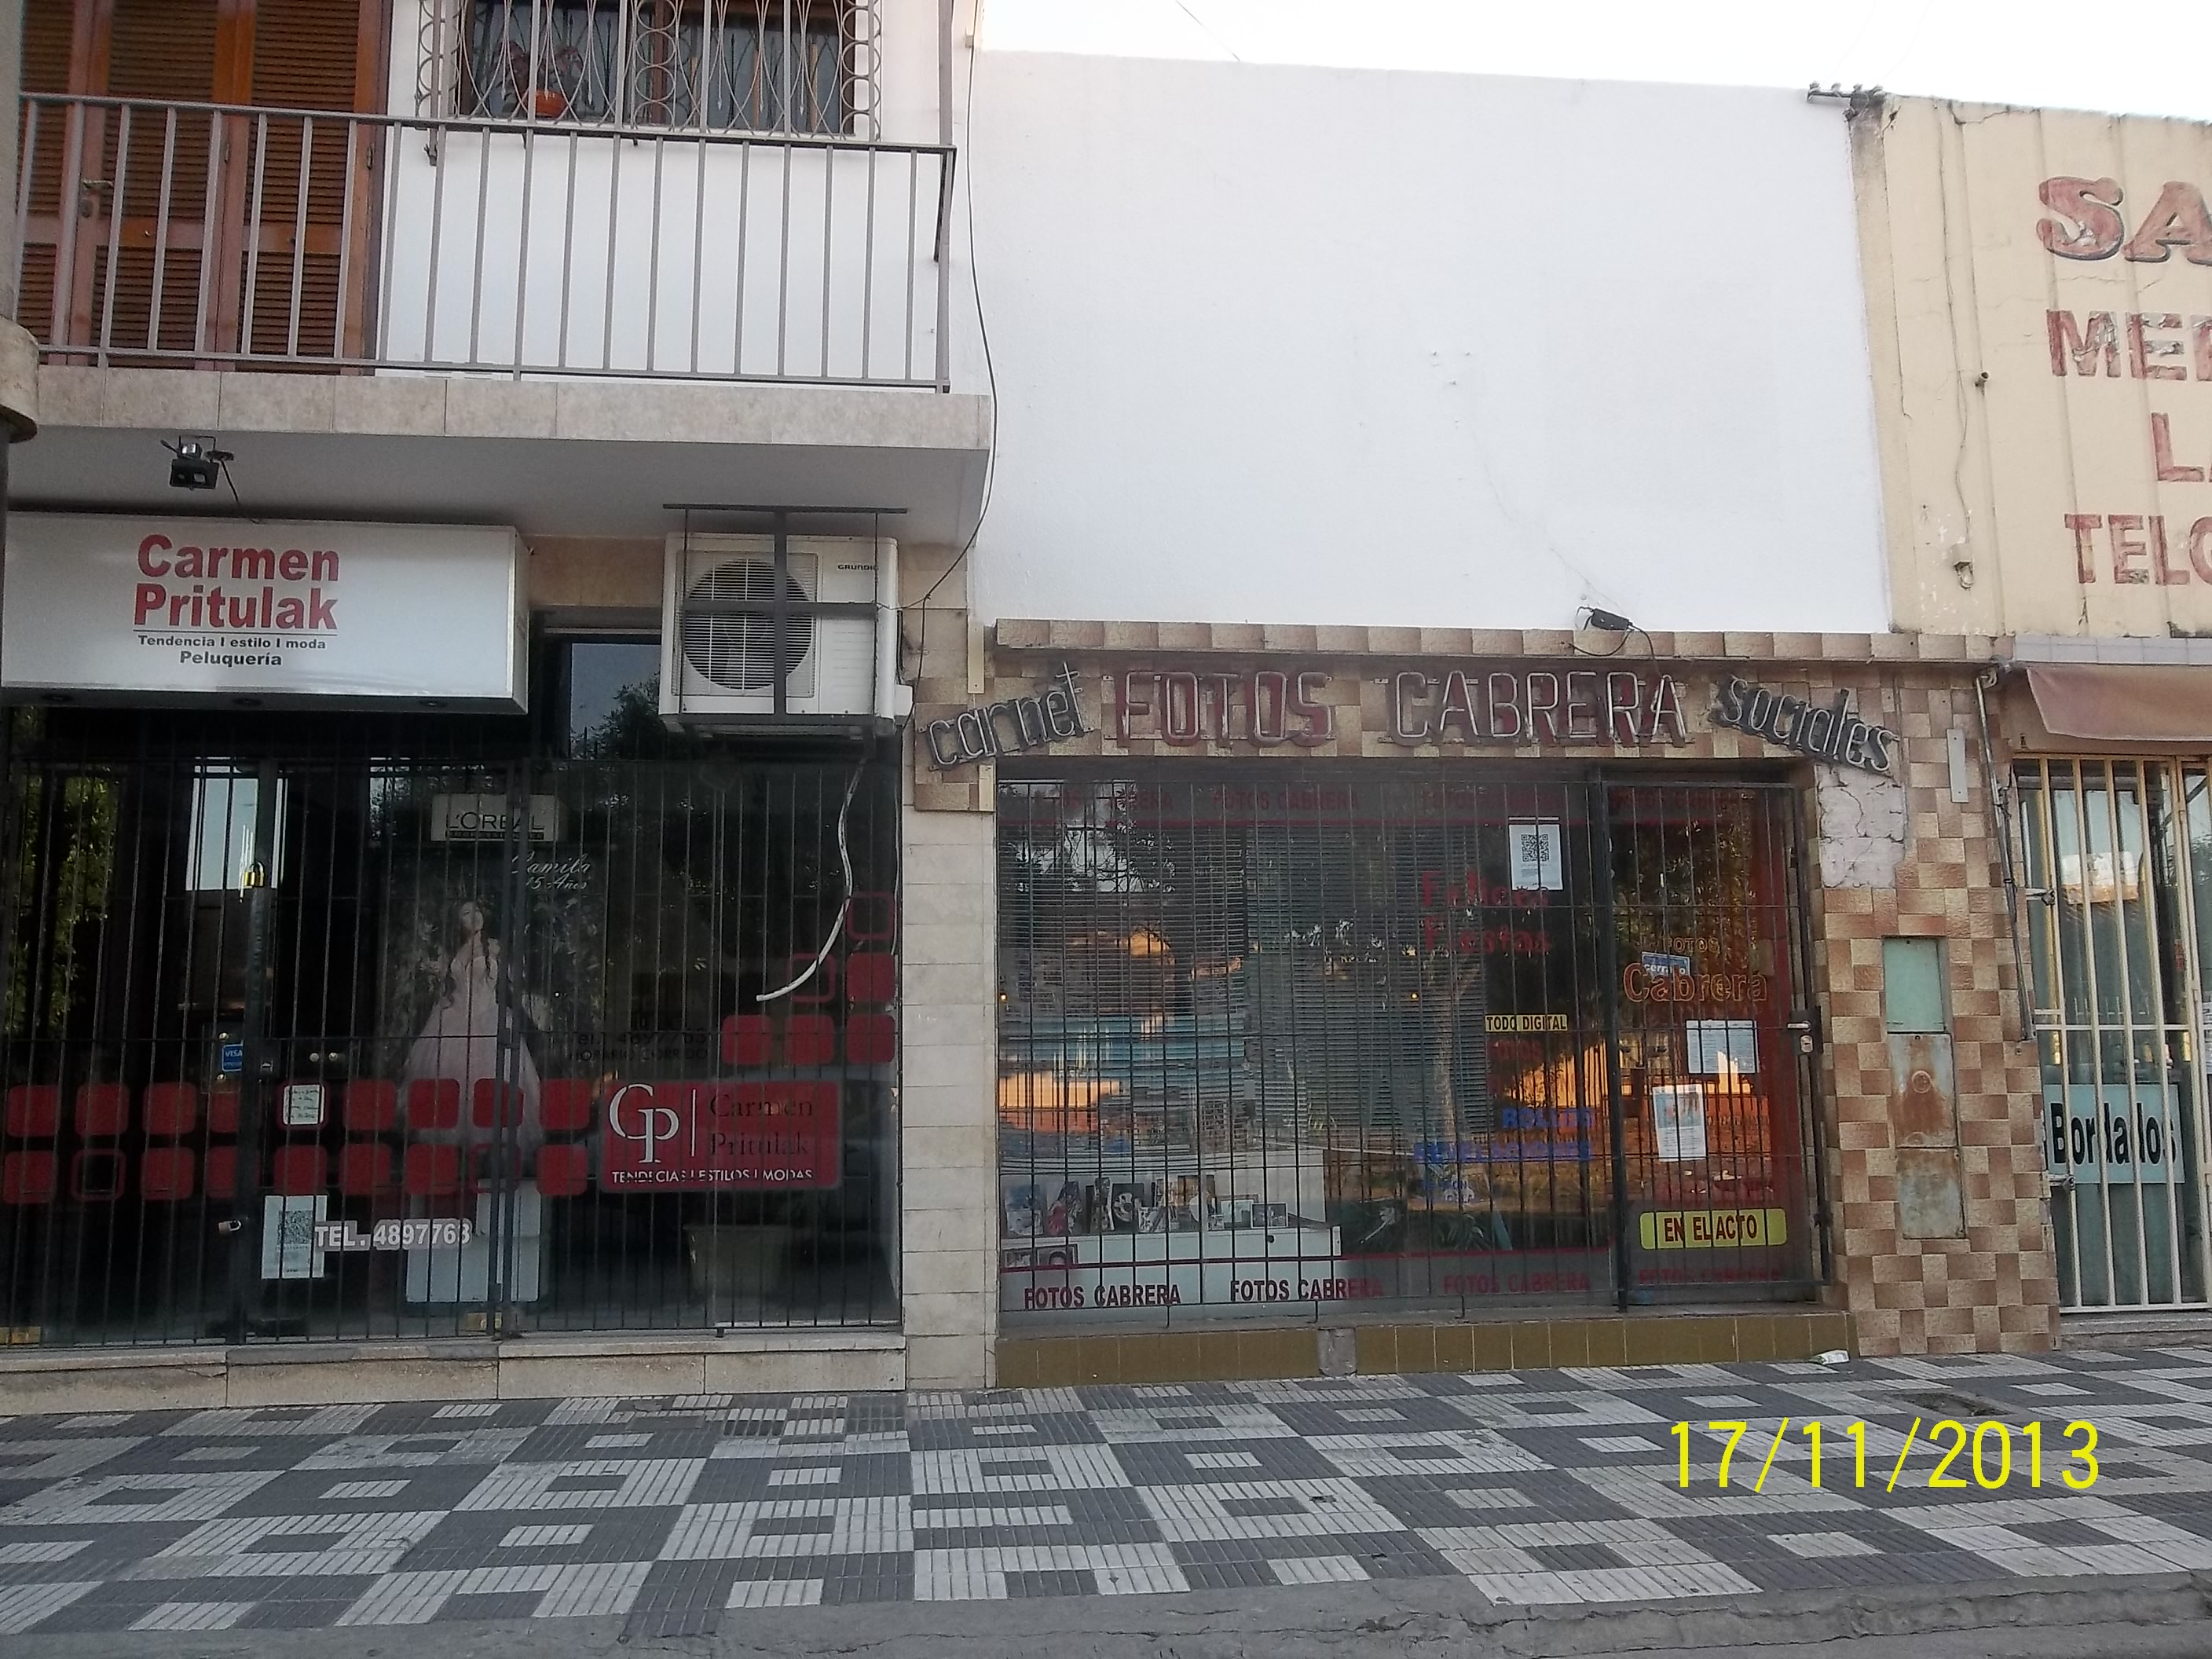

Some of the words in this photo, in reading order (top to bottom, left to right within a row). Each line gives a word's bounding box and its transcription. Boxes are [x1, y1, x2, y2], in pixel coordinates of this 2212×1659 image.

[2151, 412, 2212, 482] L
[137, 533, 339, 582] Carmen
[133, 583, 338, 630] Pritulak
[138, 635, 215, 647] Tendencia
[230, 637, 271, 648] estilo
[286, 638, 326, 650] moda
[180, 650, 282, 668] Peluquería
[927, 661, 1092, 771] carnet
[1116, 671, 1335, 749] FOTOS
[1393, 670, 1689, 749] CABRERA
[1645, 963, 1686, 976] cerro
[1624, 962, 1767, 1003] Cabrera
[1486, 1016, 1517, 1031] TODO
[1522, 1016, 1566, 1031] DIGITAL
[225, 1049, 243, 1058] VISA
[641, 1049, 708, 1061] CORRDO
[710, 1093, 813, 1118] Carmen
[710, 1132, 809, 1155] Pritulak
[315, 1225, 366, 1247] TEL.
[373, 1222, 471, 1246] 4897763
[1664, 1218, 1684, 1242] EN
[1693, 1217, 1712, 1241] EL
[1716, 1214, 1757, 1240] ACTO
[1229, 1279, 1291, 1302] FOTOS
[1298, 1278, 1384, 1300] CABRERA
[1443, 1273, 1501, 1295] FOTOS
[1507, 1272, 1591, 1293] CABRERA
[1024, 1286, 1085, 1309] FOTOS
[1094, 1284, 1182, 1308] CABRERA
